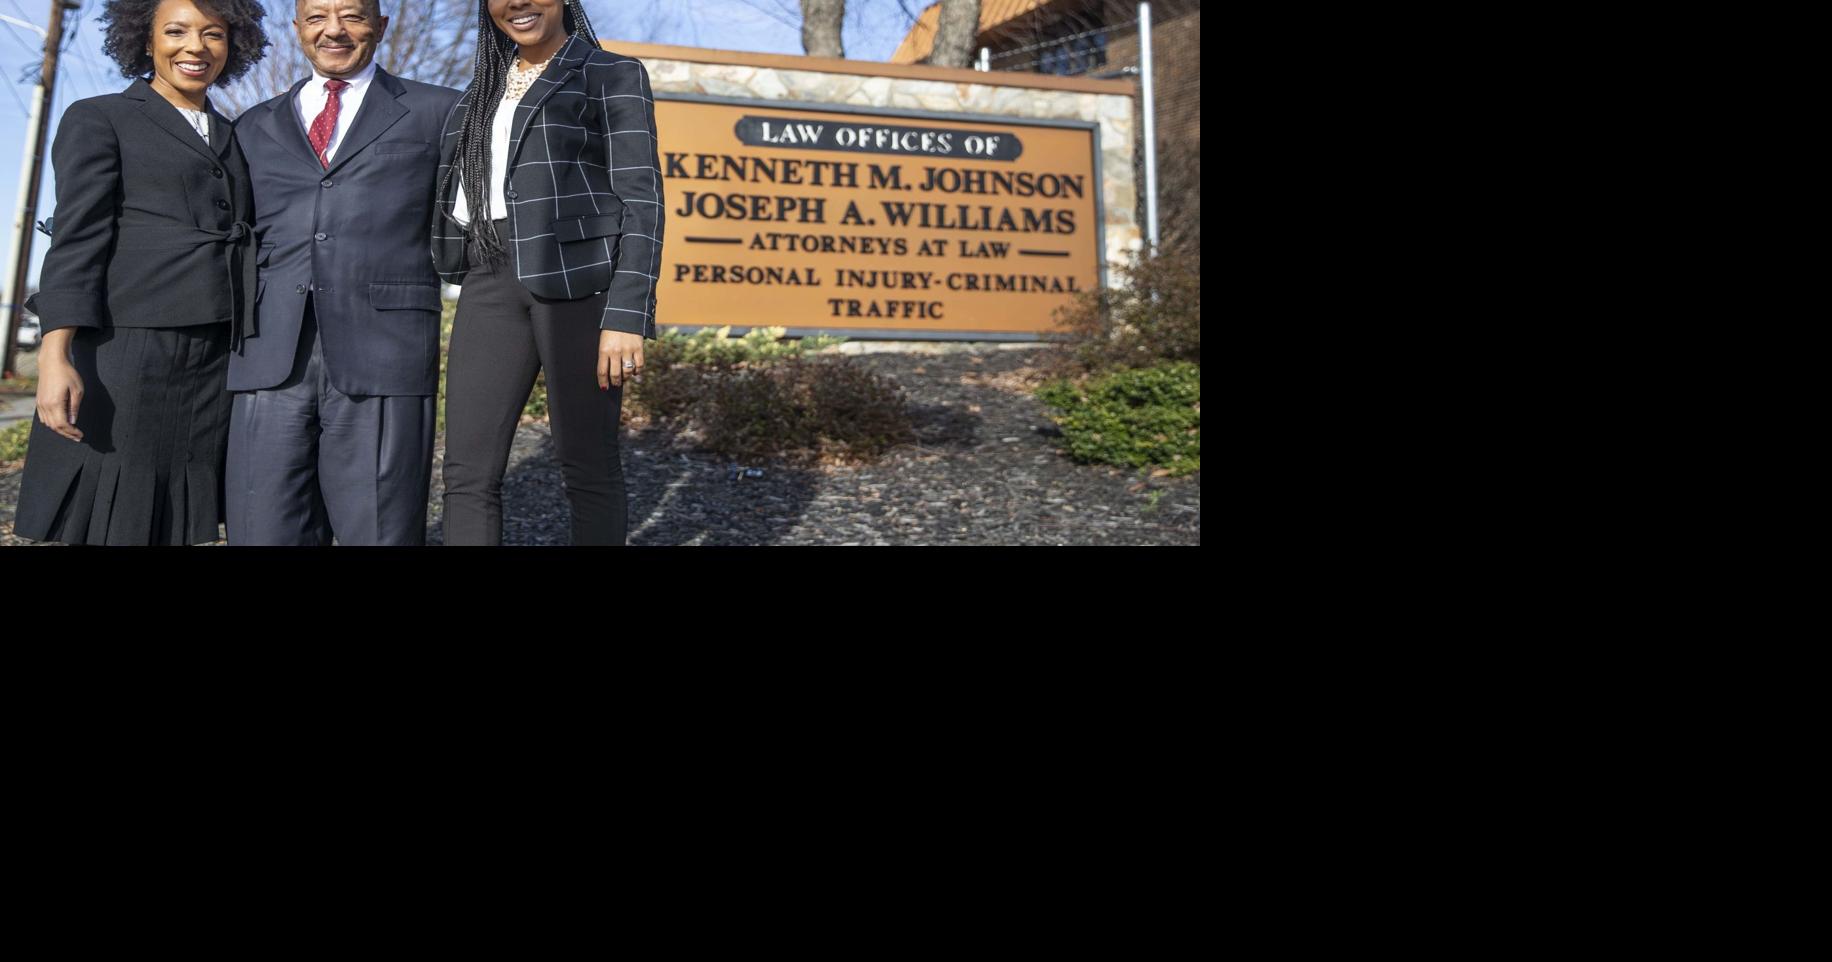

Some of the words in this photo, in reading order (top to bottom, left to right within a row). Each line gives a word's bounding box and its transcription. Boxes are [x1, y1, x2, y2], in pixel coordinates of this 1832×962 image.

[762, 121, 824, 145] LAW
[835, 127, 953, 154] OFFICES
[965, 134, 1002, 157] OF
[663, 152, 859, 189] KENNETH
[868, 163, 912, 191] M.
[920, 167, 1085, 199] JOHNSON
[676, 191, 826, 224] JOSEPH
[840, 200, 876, 226] A.
[884, 202, 1077, 235] WILLIAMS
[749, 232, 908, 256] ATTORNEYS
[917, 238, 948, 258] AT
[960, 240, 1011, 259] LAW
[674, 264, 821, 286] PERSONAL
[828, 299, 943, 319] TRAFFIC
